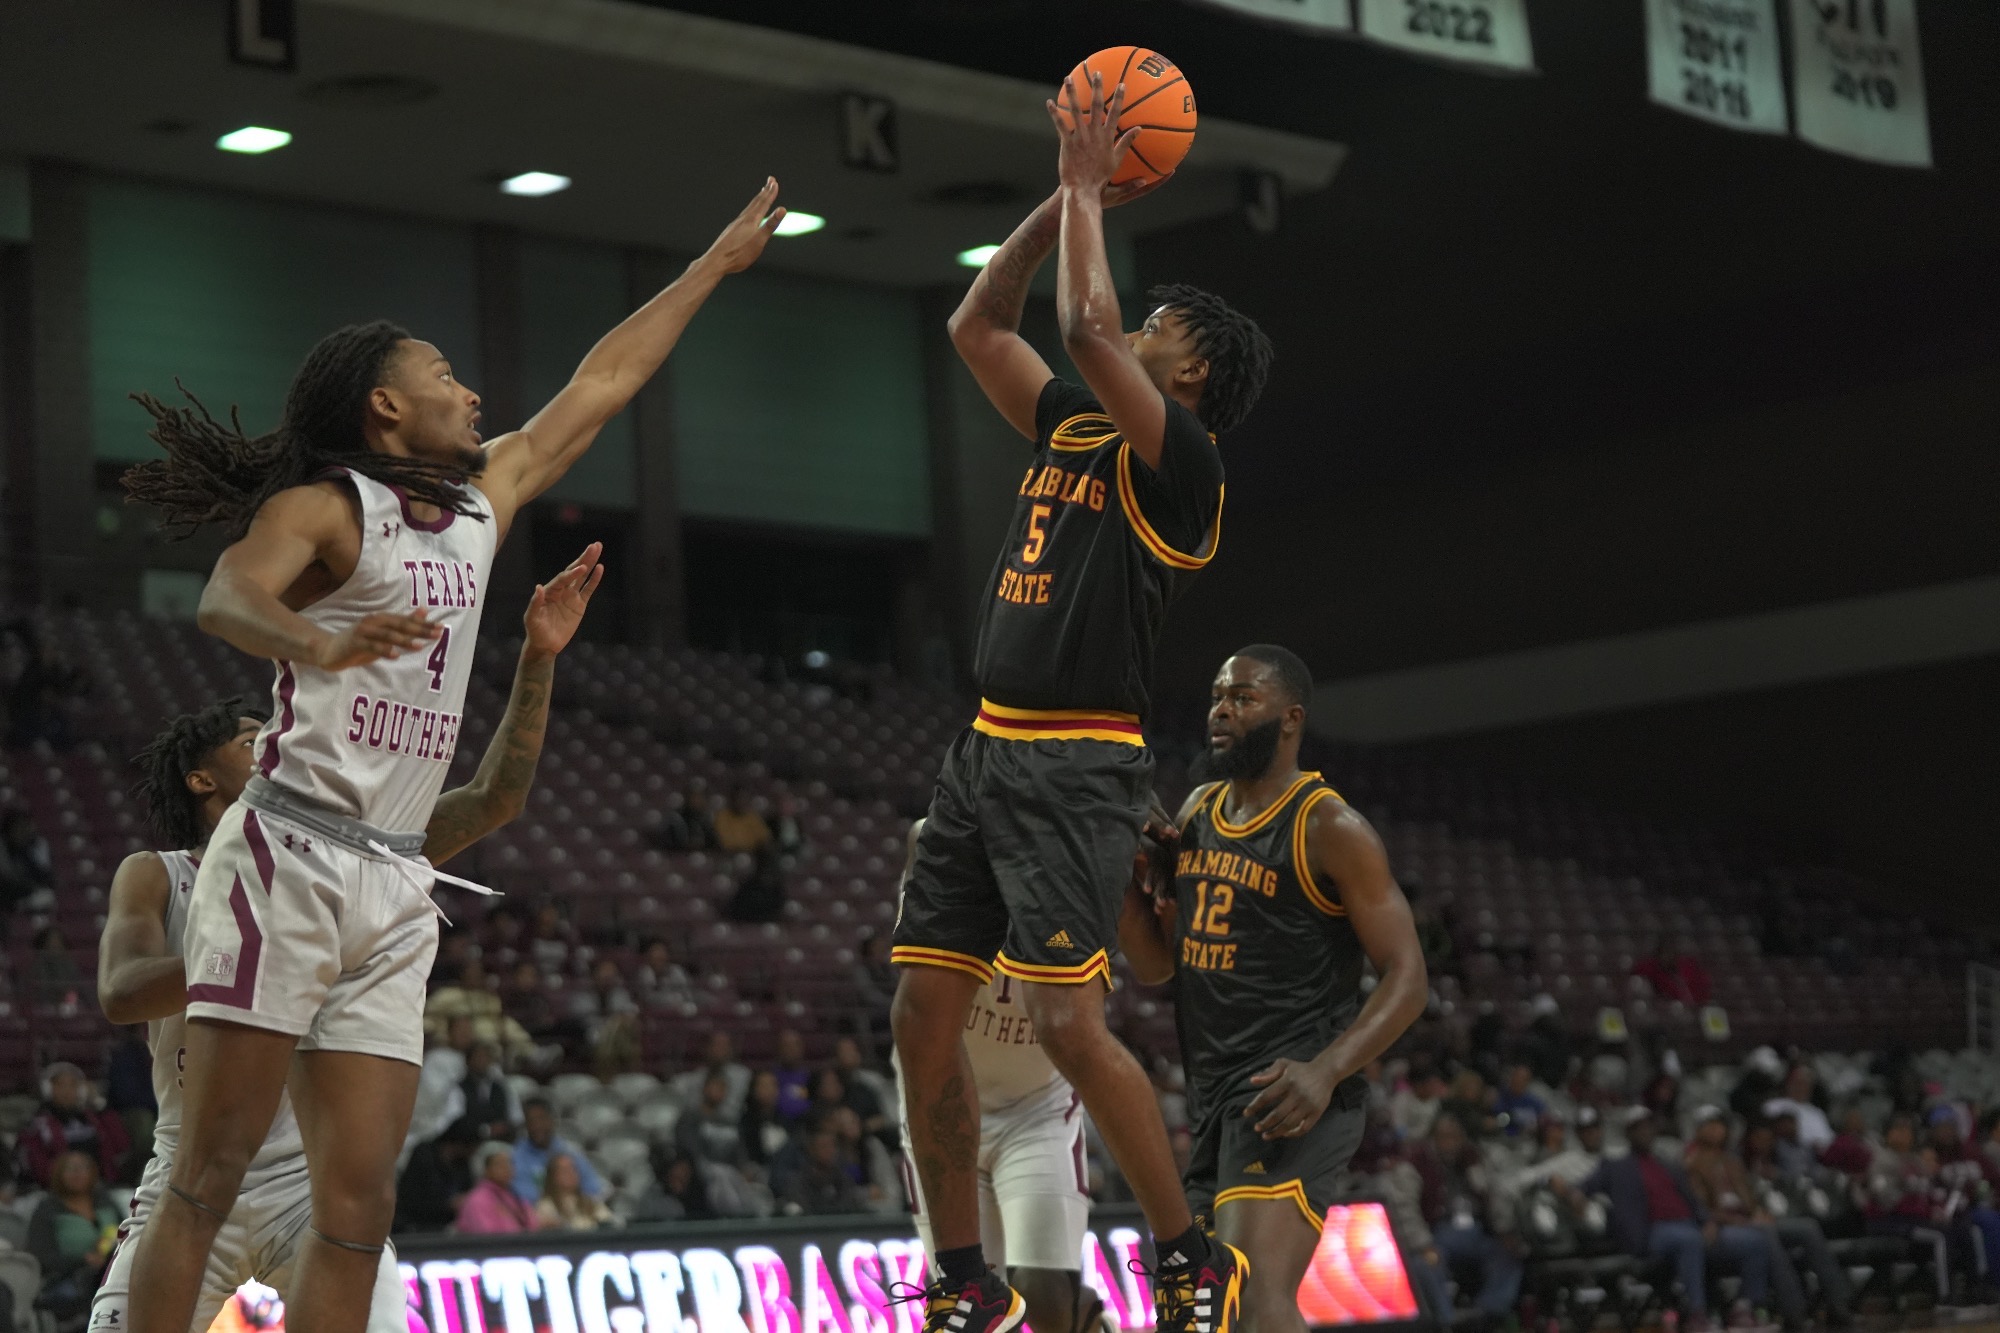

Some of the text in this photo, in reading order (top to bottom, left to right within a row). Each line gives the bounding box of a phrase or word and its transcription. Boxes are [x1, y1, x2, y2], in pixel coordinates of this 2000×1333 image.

[847, 96, 892, 166] K
[1022, 503, 1052, 565] 5
[402, 559, 478, 608] TEXAS
[997, 567, 1053, 605] STATE
[425, 624, 452, 693] 4
[348, 693, 463, 763] SOUTHER
[1191, 880, 1235, 936] 12
[1045, 940, 1074, 950] adidas
[1182, 935, 1238, 971] STATE
